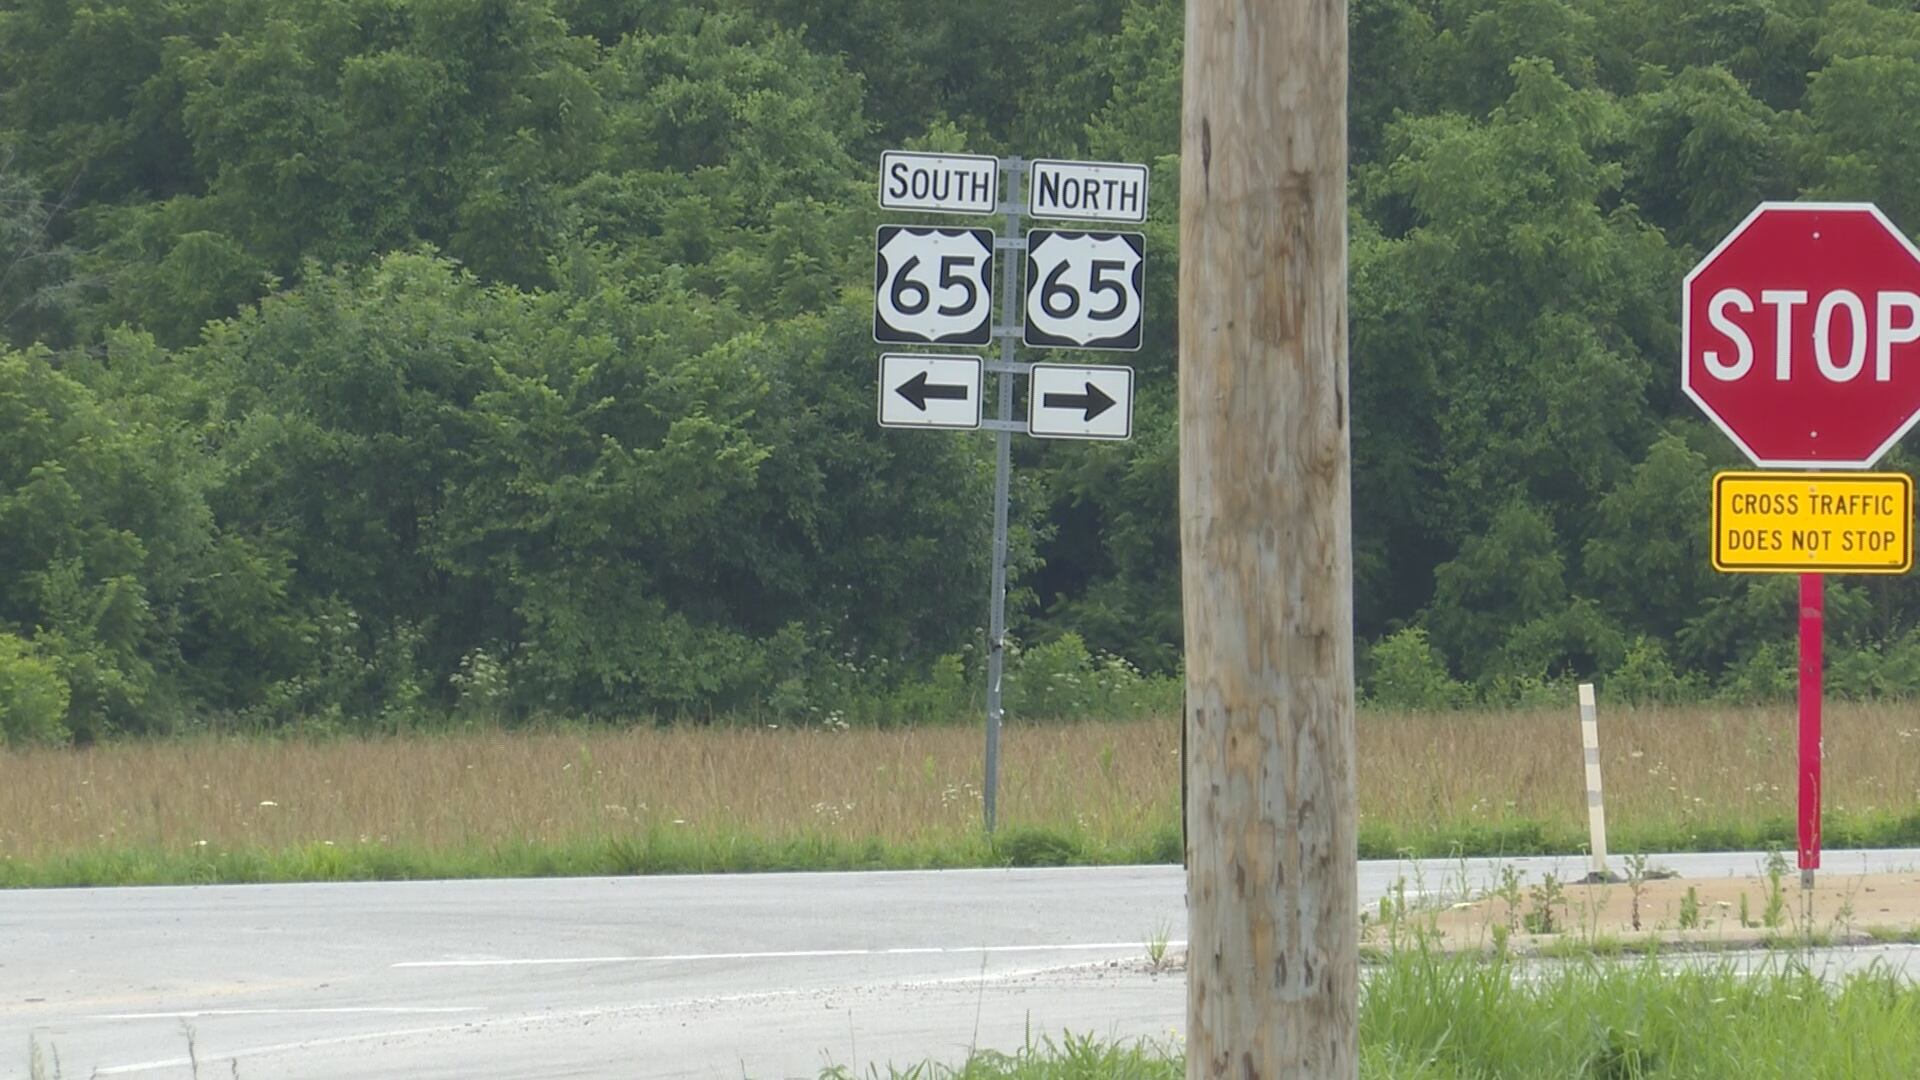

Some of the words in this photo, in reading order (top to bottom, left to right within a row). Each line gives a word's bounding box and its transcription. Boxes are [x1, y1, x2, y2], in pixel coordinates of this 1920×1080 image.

[889, 162, 990, 203] SOUTH
[1038, 171, 1139, 212] NORTH
[890, 254, 978, 317] 65
[1040, 258, 1128, 322] 65
[1702, 288, 1920, 382] STOP
[1731, 493, 1799, 515] CROSS
[1810, 494, 1894, 516] TRAFFIC
[1728, 530, 1782, 550] DOES
[1792, 530, 1832, 551] NOT
[1842, 531, 1896, 552] STOP
